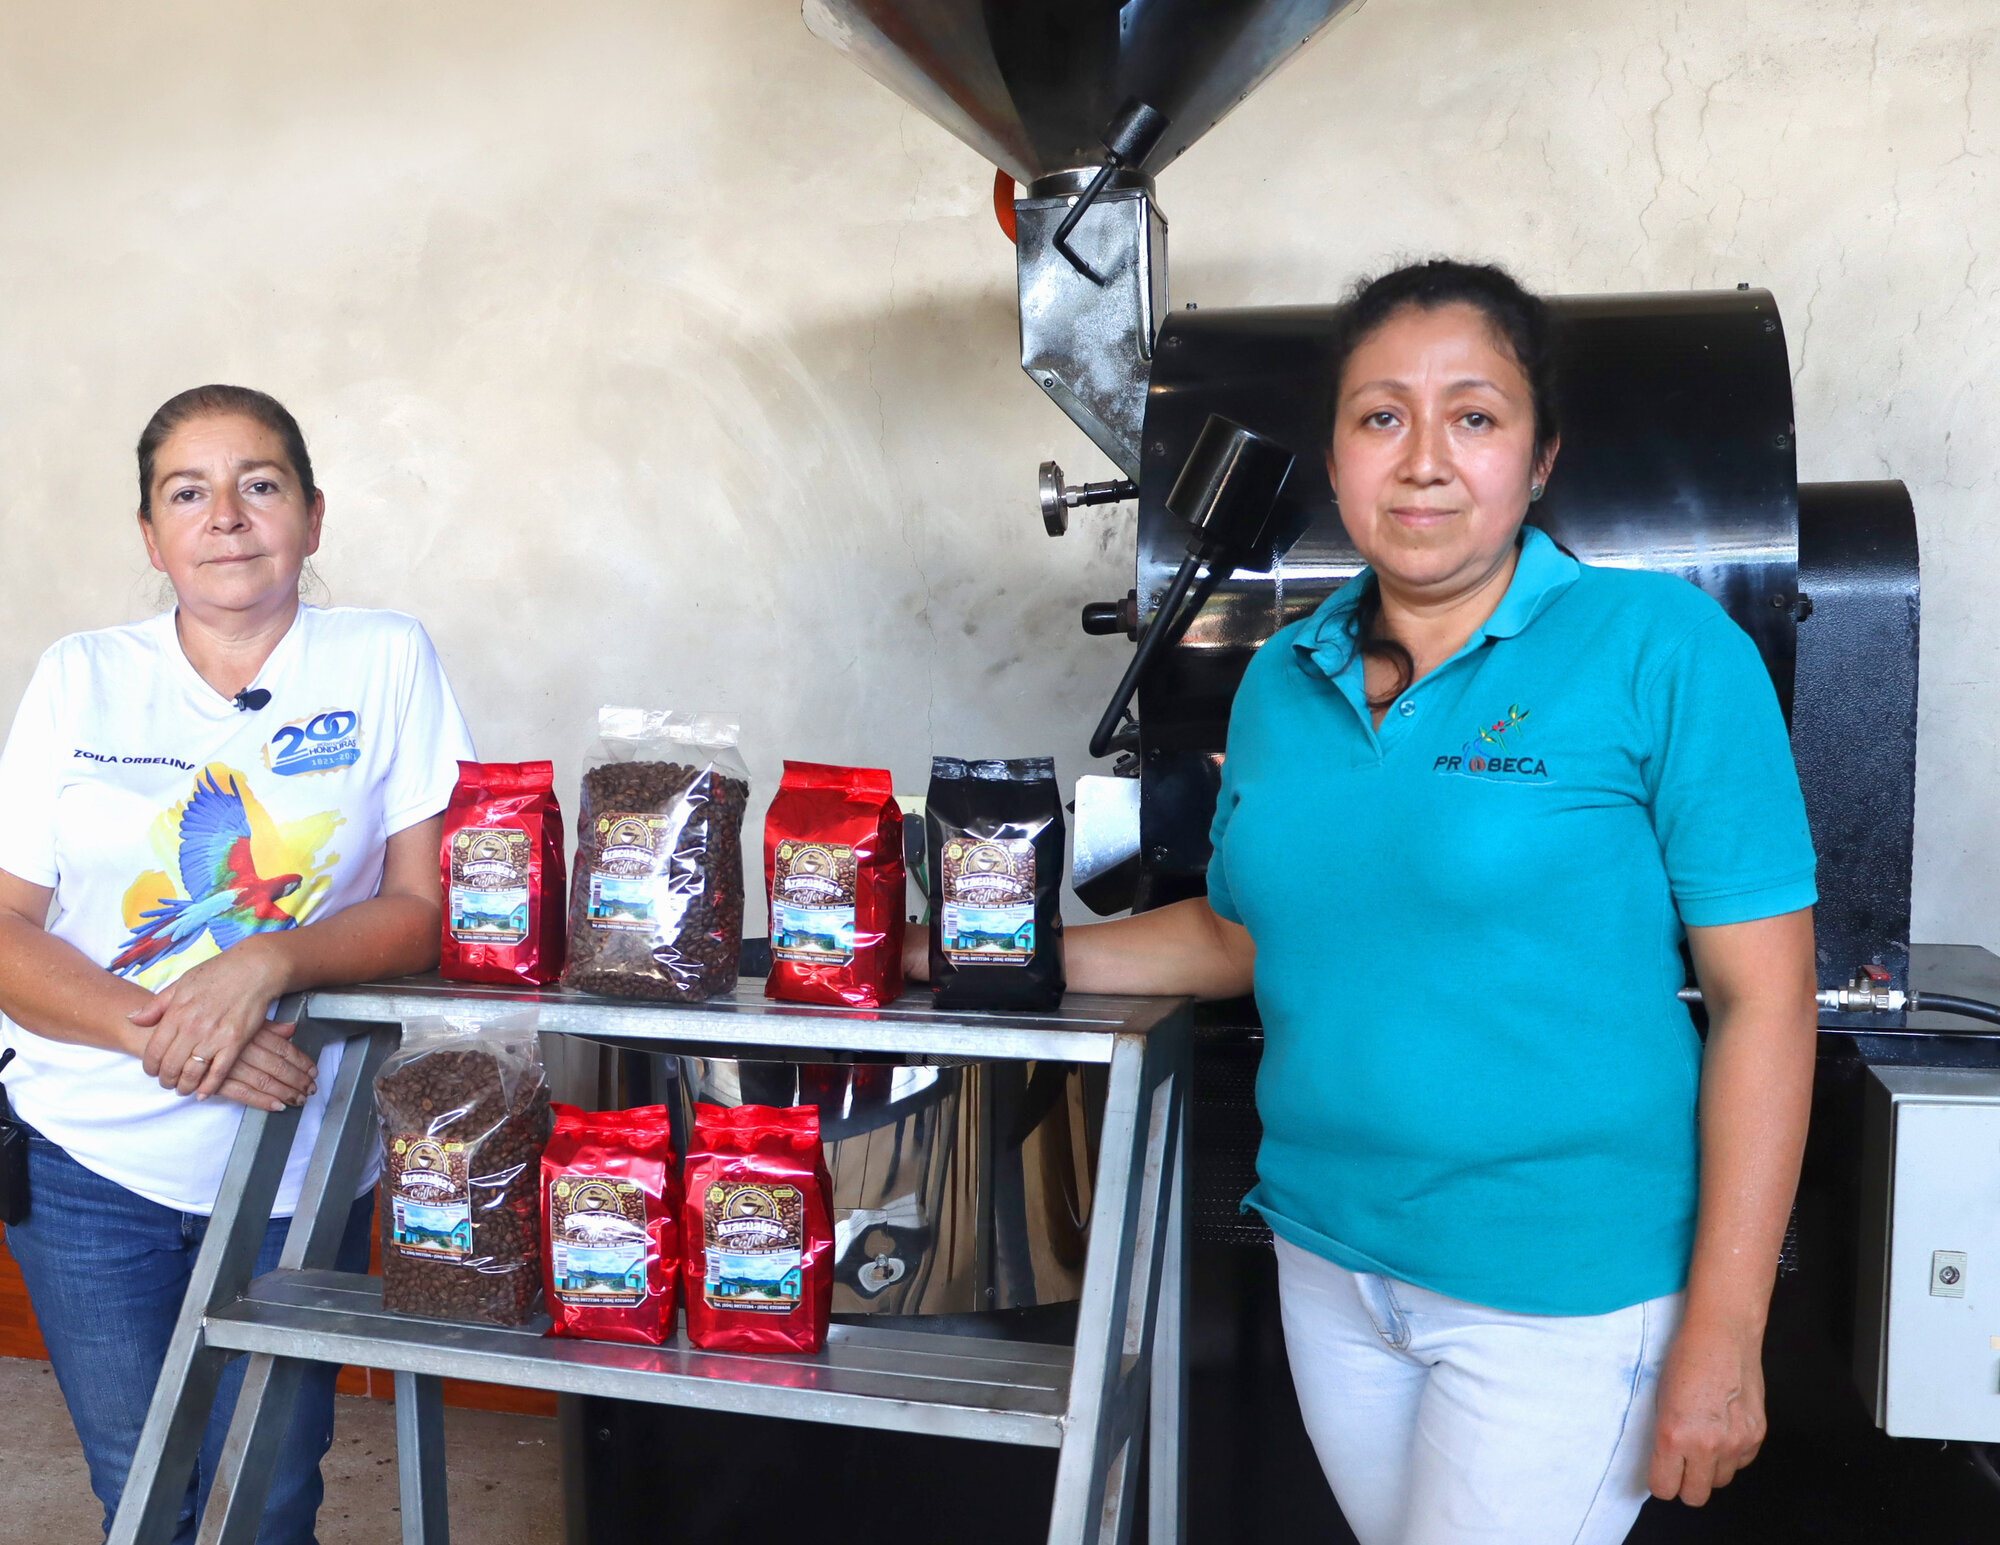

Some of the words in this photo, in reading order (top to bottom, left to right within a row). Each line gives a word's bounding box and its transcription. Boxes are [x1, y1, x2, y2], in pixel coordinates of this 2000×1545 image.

[272, 710, 357, 760] 200
[73, 749, 118, 763] ZOILA
[309, 739, 357, 756] HONDURAS
